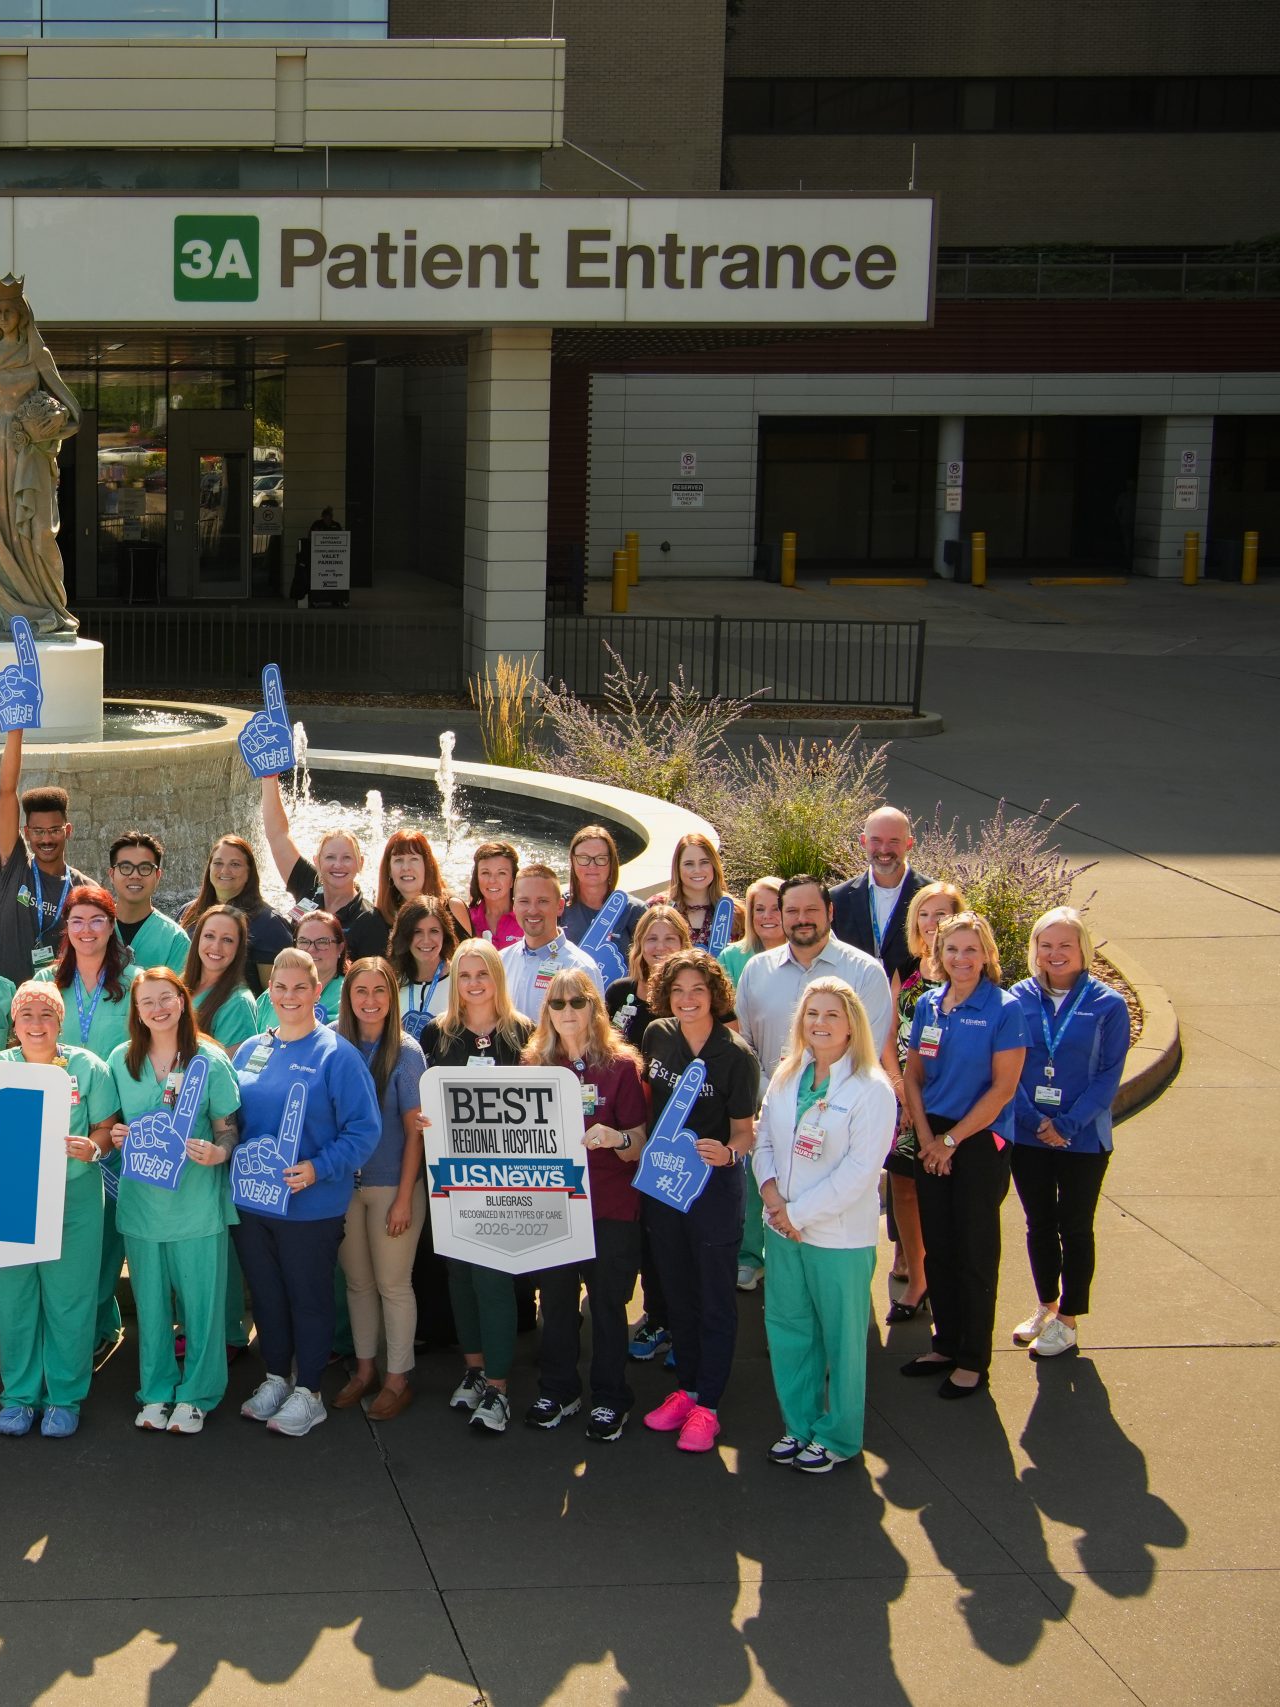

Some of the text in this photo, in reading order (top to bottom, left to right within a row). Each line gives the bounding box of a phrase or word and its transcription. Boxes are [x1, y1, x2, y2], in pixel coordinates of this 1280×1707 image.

[179, 238, 253, 280] 3A
[279, 227, 899, 290] Patient Entrance
[18, 632, 35, 665] #1
[268, 679, 281, 710] #1
[0, 703, 34, 725] WE'RE
[253, 746, 290, 771] WE'RE
[712, 913, 729, 949] #1
[657, 1066, 668, 1081] St.
[179, 1076, 200, 1117] #1
[448, 1087, 553, 1125] BEST
[283, 1099, 300, 1142] #1
[452, 1128, 557, 1154] REGIONAL HOSPITALS
[130, 1152, 174, 1180] WE'RE
[650, 1151, 686, 1173] WE'RE
[238, 1179, 281, 1205] WE'RE
[485, 1195, 533, 1207] BLUEGRASS
[655, 1171, 692, 1203] #1
[459, 1209, 563, 1220] RECOGNIZED IN 21 TYPES OF CARE
[475, 1222, 549, 1236] 2026-2027
